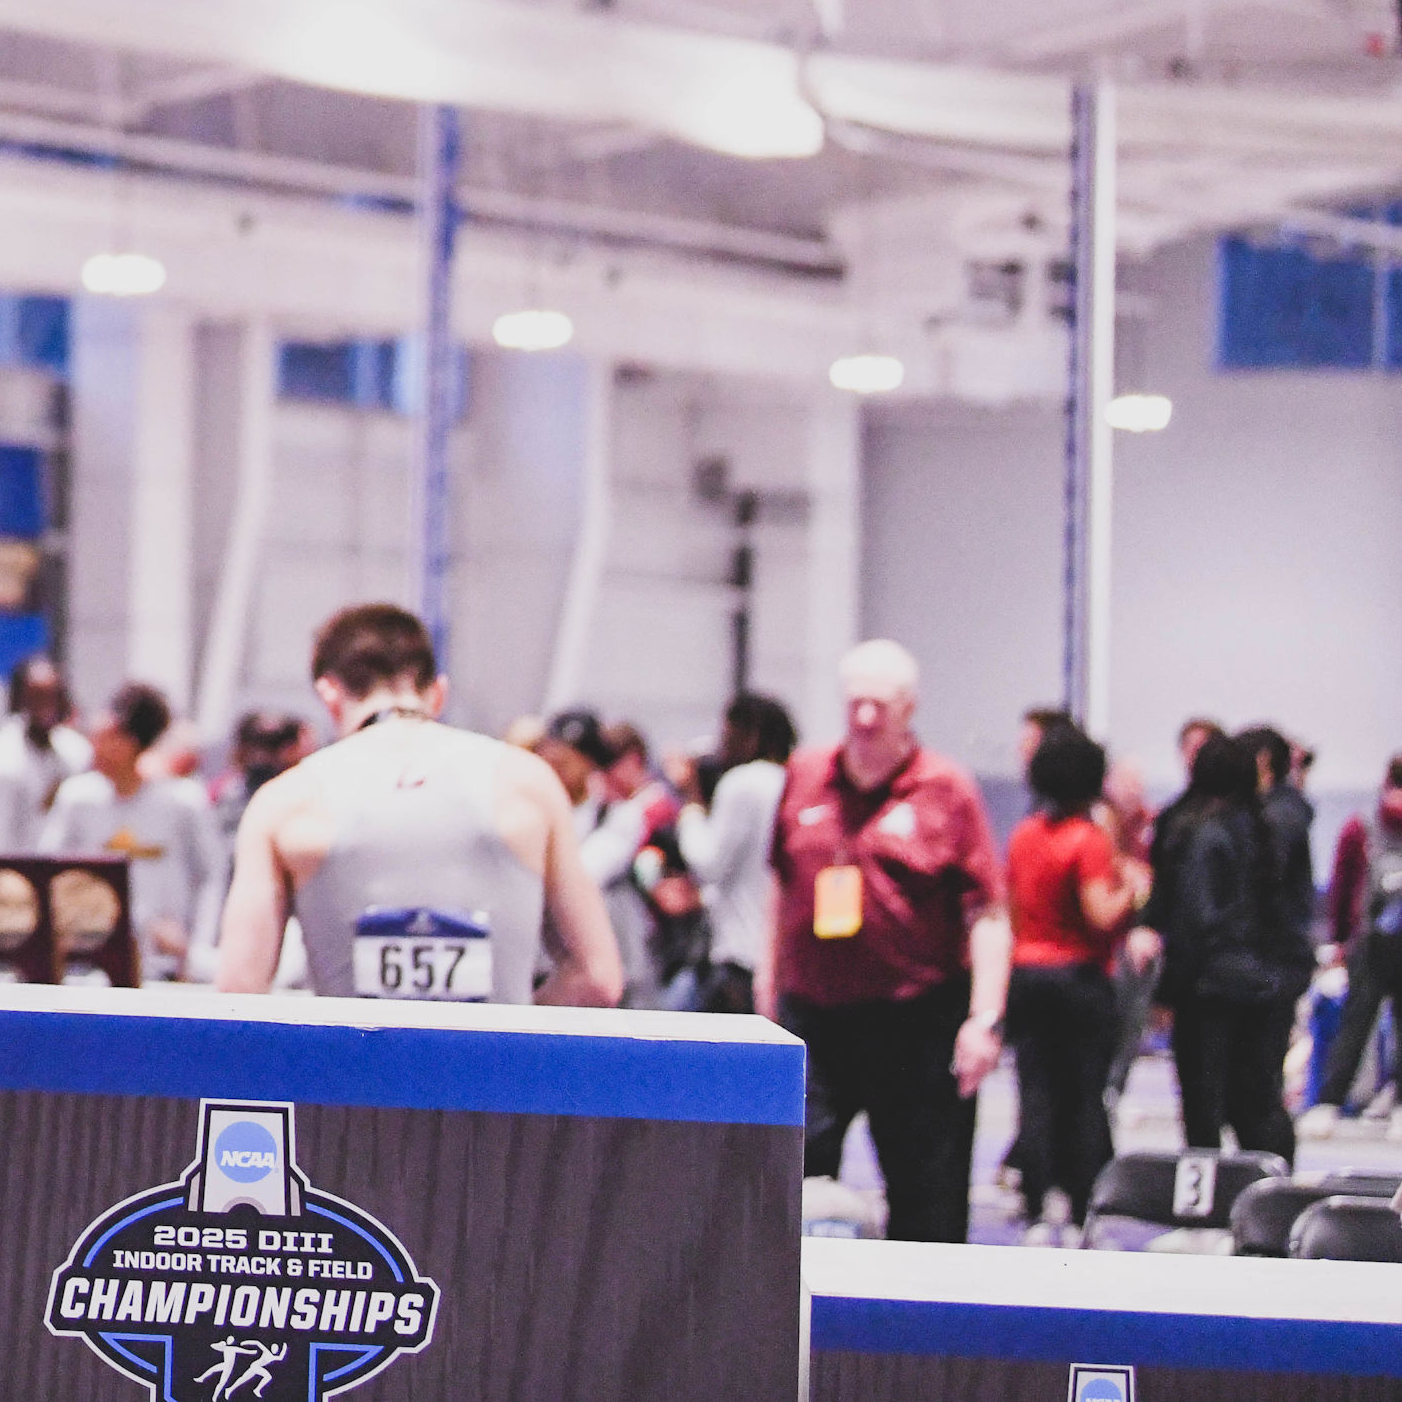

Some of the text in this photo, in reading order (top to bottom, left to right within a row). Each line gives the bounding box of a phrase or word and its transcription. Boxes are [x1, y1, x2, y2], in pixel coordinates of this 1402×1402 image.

[380, 945, 466, 991] 657
[221, 1150, 275, 1169] NCAA
[153, 1225, 333, 1254] 2025 DIII
[113, 1250, 373, 1280] INDOOR TRACK & FIELD
[60, 1277, 424, 1335] CHAMPIONSHIPS
